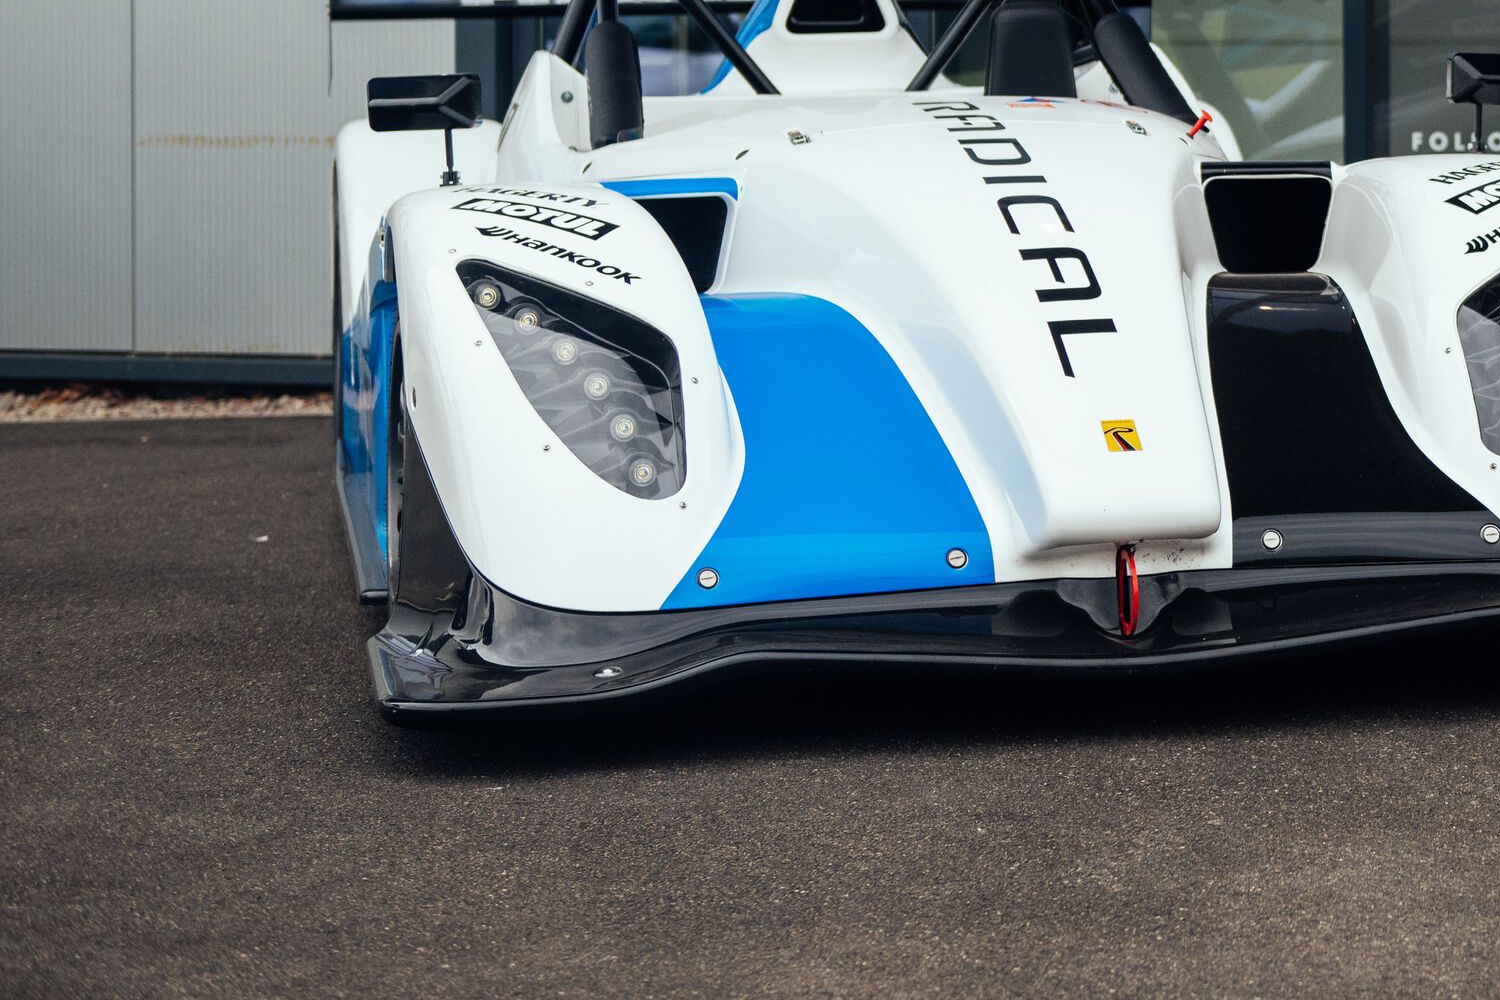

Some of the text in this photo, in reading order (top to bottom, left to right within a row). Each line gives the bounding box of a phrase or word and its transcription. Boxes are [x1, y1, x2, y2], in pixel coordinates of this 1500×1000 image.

[452, 187, 611, 207] HAGERTY
[459, 199, 606, 239] MOTUL
[911, 100, 1118, 378] RADICAL
